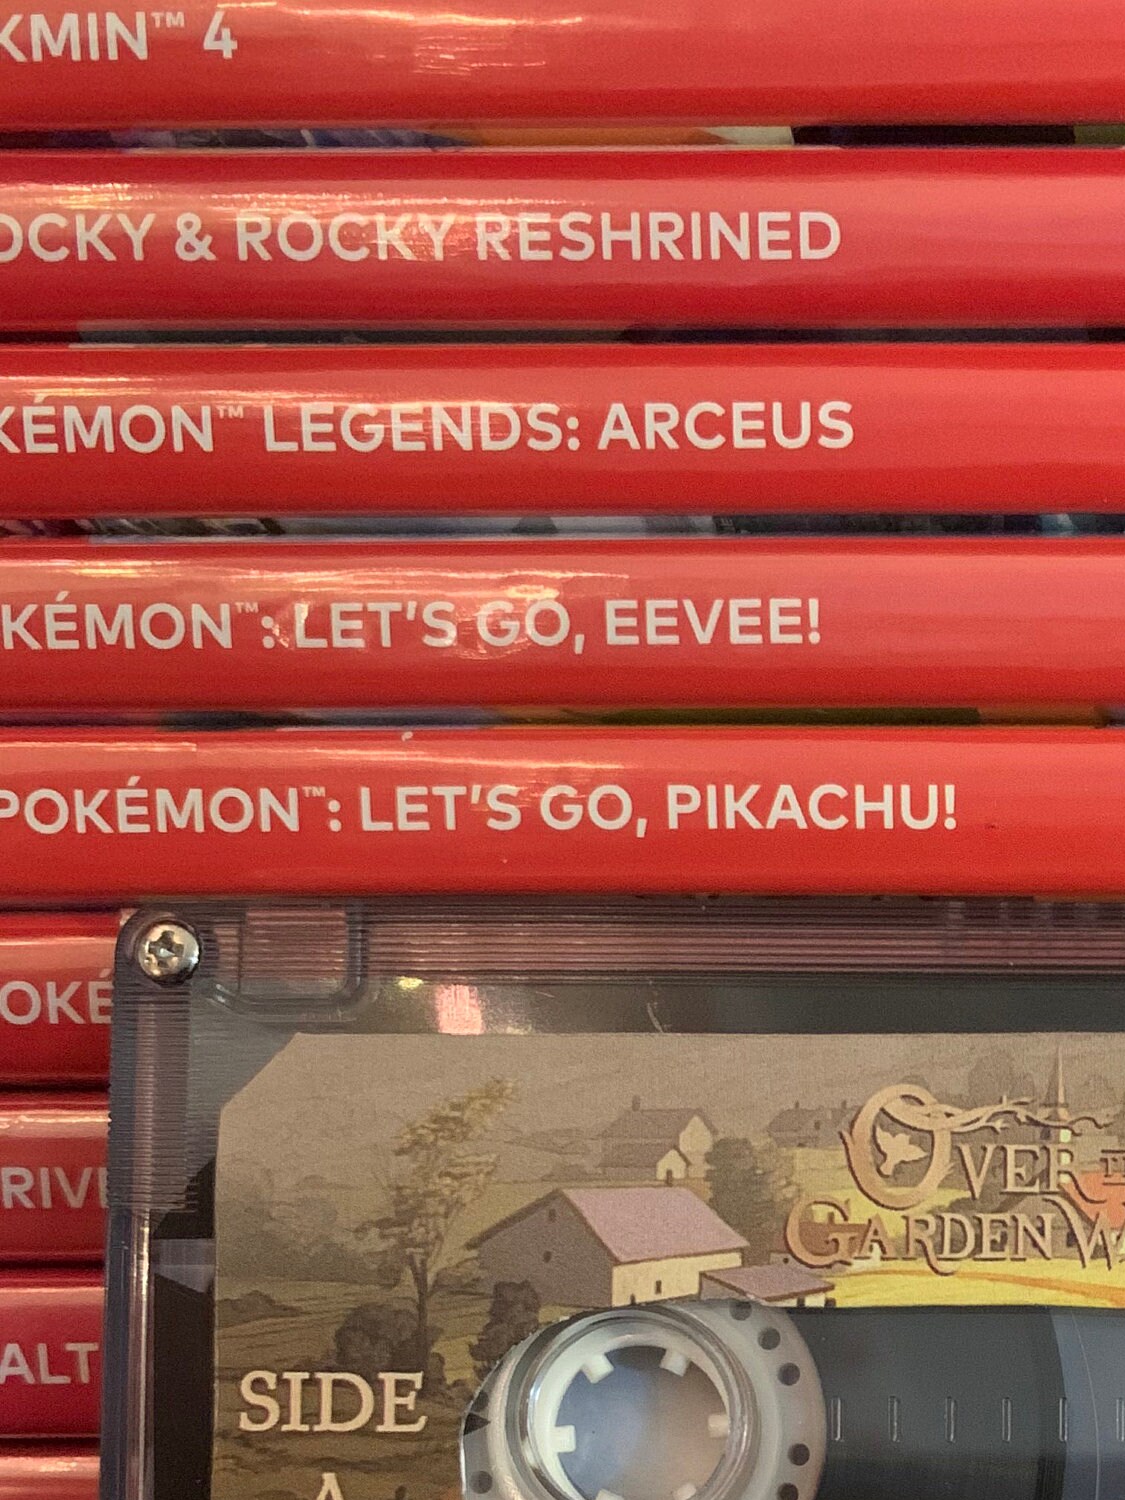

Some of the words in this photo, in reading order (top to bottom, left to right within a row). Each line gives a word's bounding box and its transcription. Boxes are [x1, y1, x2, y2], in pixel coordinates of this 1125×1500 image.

[202, 15, 238, 60] 4
[174, 213, 216, 262] &
[237, 212, 457, 262] ROCKY
[476, 210, 842, 262] RESHRINED
[264, 401, 580, 452] LEGENDS:
[598, 401, 855, 451] ARCEUS
[290, 599, 458, 649] LET'S
[475, 596, 585, 657] GO,
[606, 597, 821, 647] EEVEE!
[359, 784, 522, 833] LET'S
[539, 783, 649, 839] GO,
[667, 781, 958, 832] PIKACHU!
[840, 1083, 1108, 1211] OVER
[0, 1341, 98, 1386] ALT
[238, 1369, 429, 1433] SIDE
